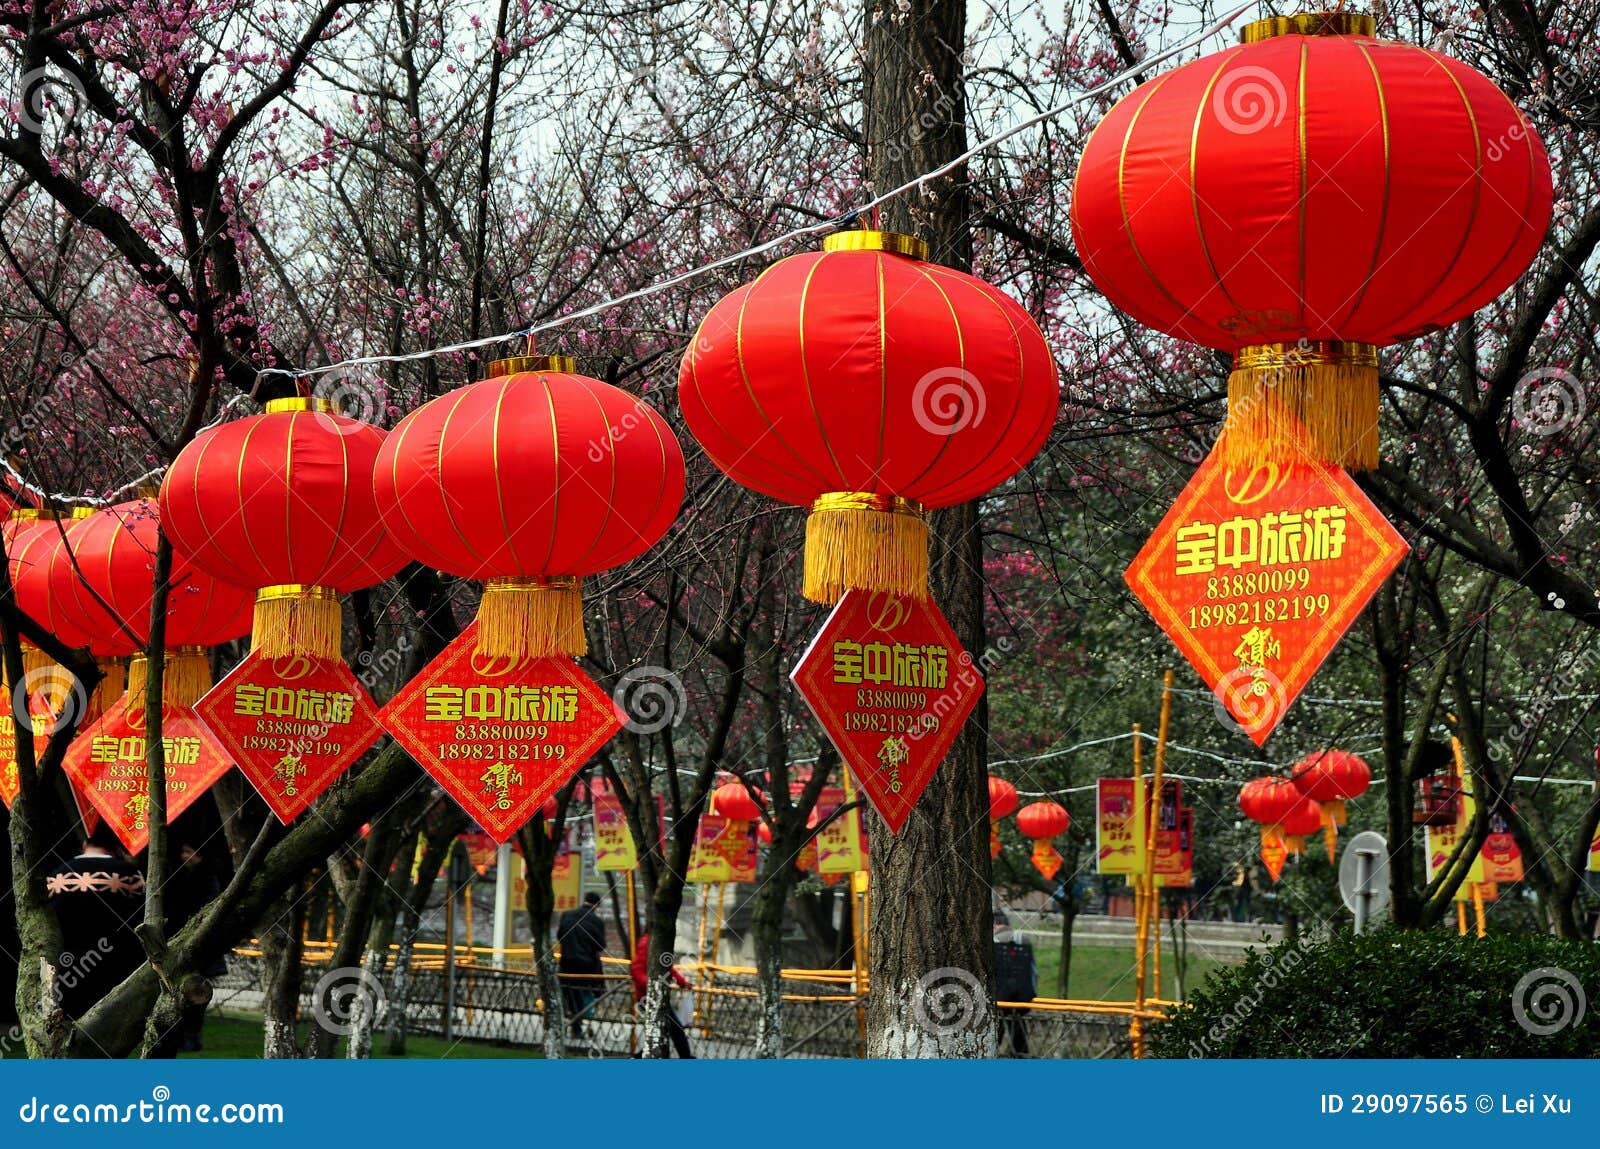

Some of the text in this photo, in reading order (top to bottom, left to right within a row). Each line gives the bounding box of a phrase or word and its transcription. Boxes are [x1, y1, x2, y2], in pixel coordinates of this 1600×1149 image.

[1175, 504, 1347, 576] 宝中旅游
[1206, 567, 1311, 600] 83880099
[1188, 594, 1330, 629] 18982182199
[833, 638, 949, 689] 宝中旅游
[233, 682, 354, 725] 宝中旅游
[425, 684, 579, 722] 宝中旅游
[857, 688, 927, 711] 83880099
[256, 719, 329, 738] 83880099
[455, 723, 549, 741] 83880099
[844, 712, 940, 735] 18982182199
[242, 735, 341, 756] 18982182199
[437, 744, 566, 761] 18982182199
